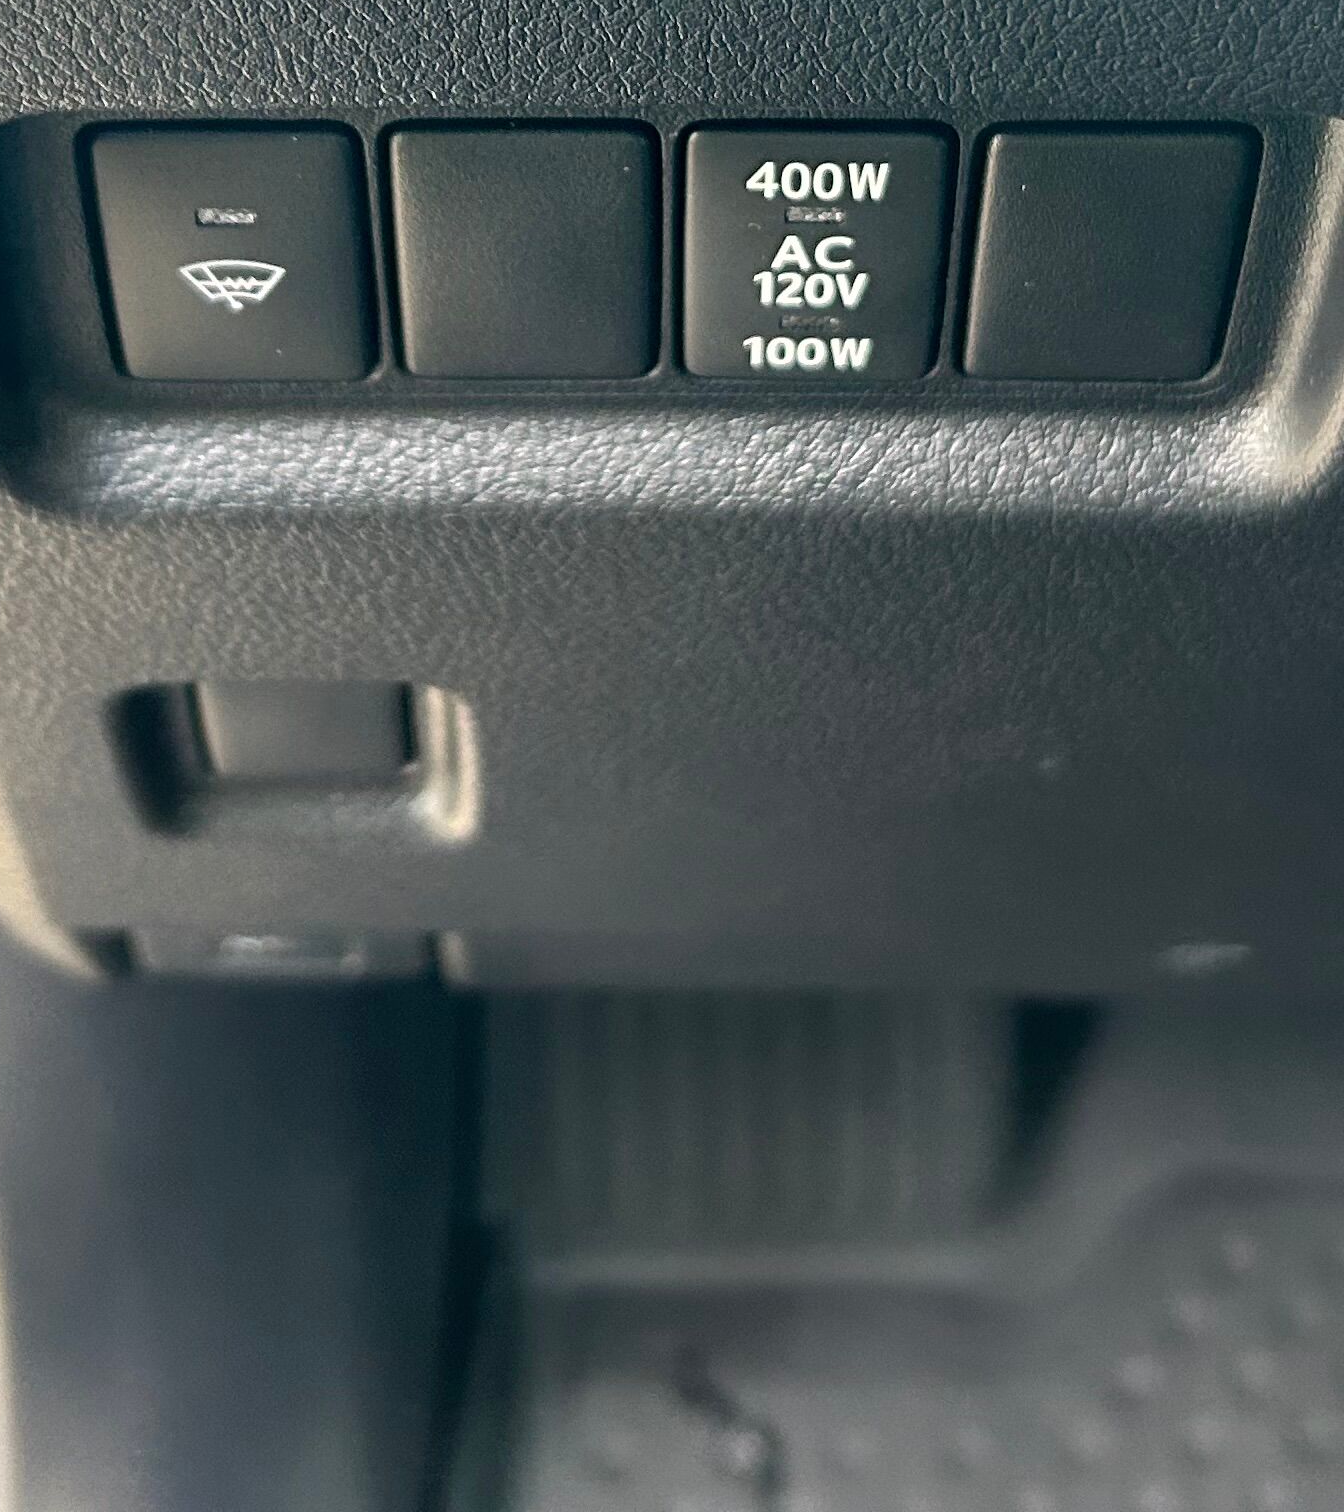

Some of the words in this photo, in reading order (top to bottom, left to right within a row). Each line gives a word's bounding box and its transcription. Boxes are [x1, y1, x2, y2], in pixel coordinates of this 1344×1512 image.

[746, 161, 890, 202] 400W
[771, 235, 855, 272] AC
[753, 271, 870, 309] 120V
[742, 336, 873, 372] 100W
